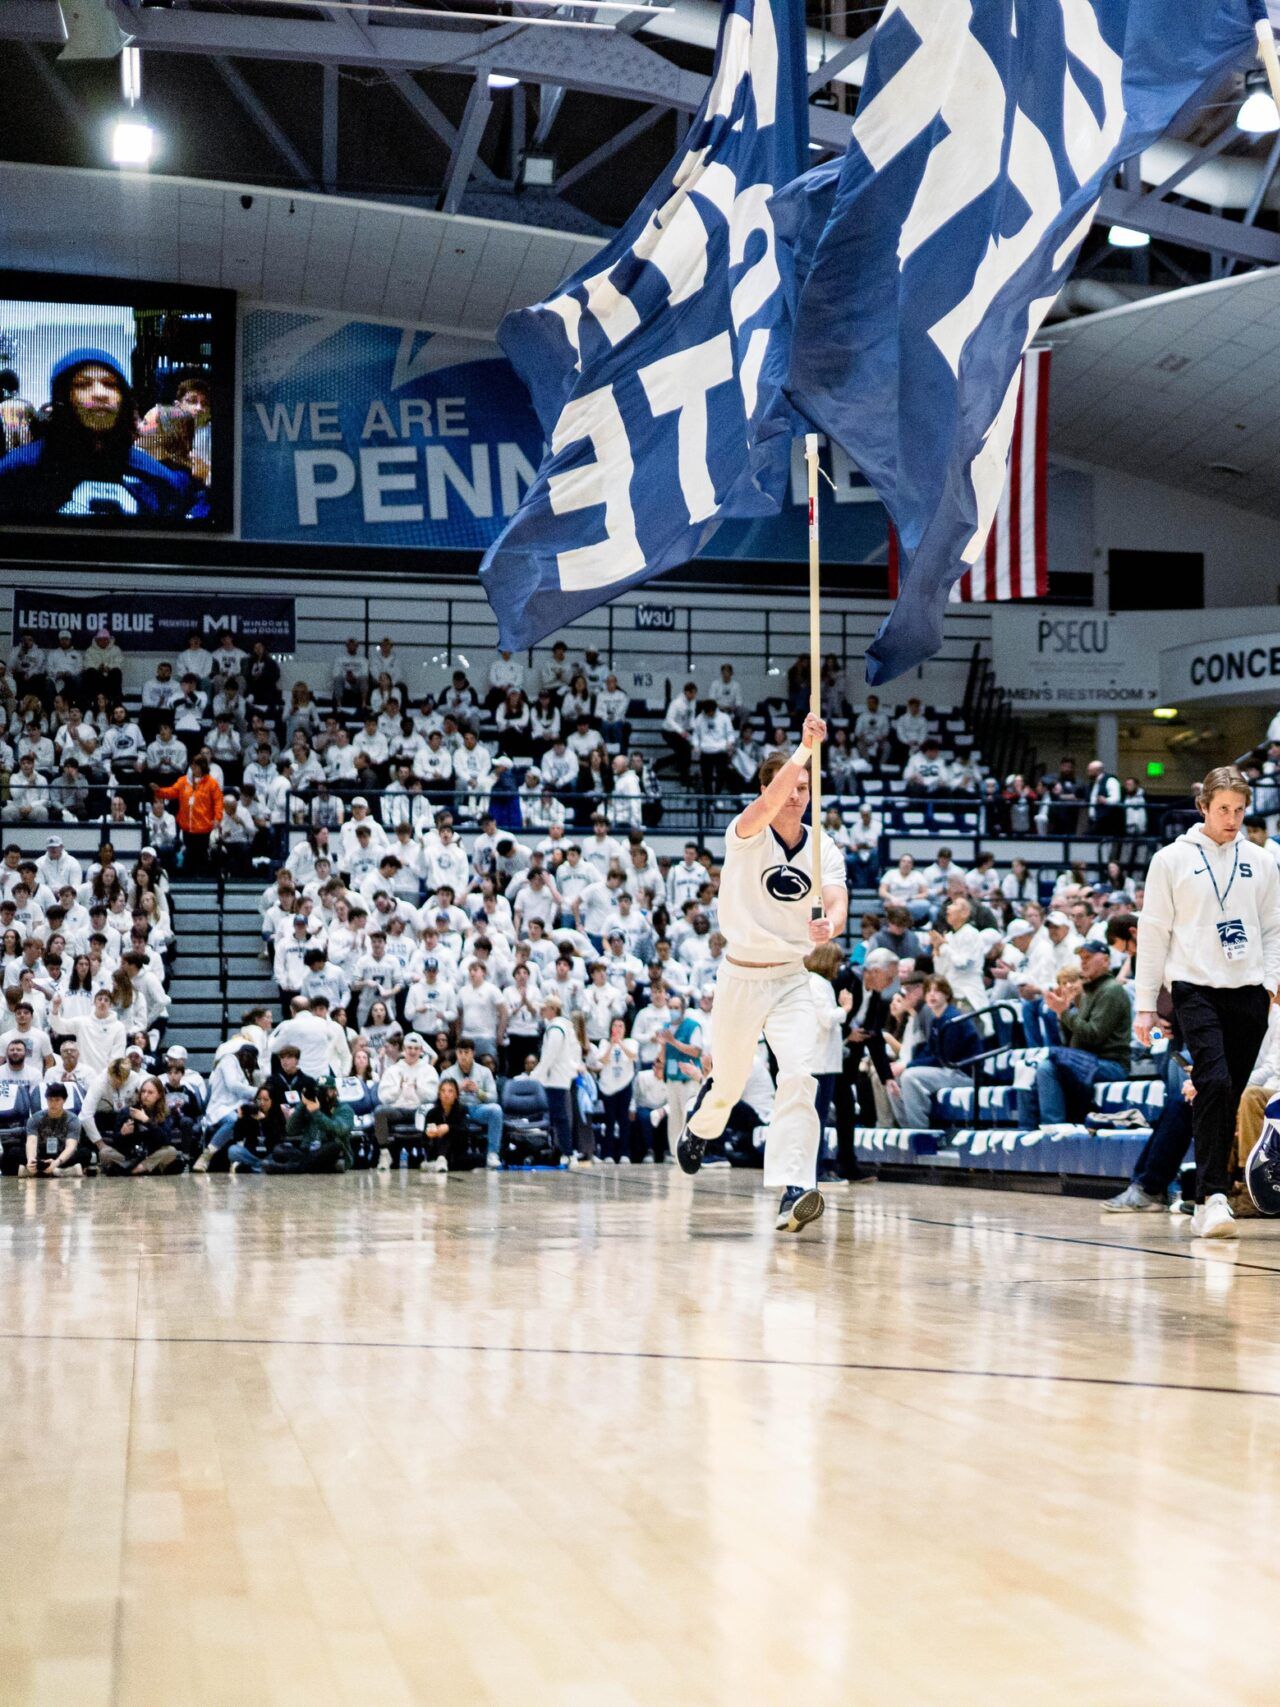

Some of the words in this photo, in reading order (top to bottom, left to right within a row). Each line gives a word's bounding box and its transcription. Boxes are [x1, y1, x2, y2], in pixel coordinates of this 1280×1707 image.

[255, 401, 343, 442] WE
[360, 397, 470, 440] ARE
[294, 441, 548, 526] PENN
[18, 609, 82, 631] LEGION
[86, 612, 108, 632] OF
[112, 612, 154, 632] BLUE
[203, 614, 238, 634] MI
[638, 610, 674, 627] W3U
[1037, 619, 1109, 654] PSECU
[1057, 687, 1143, 700] RESTROOM
[1239, 863, 1253, 878] S
